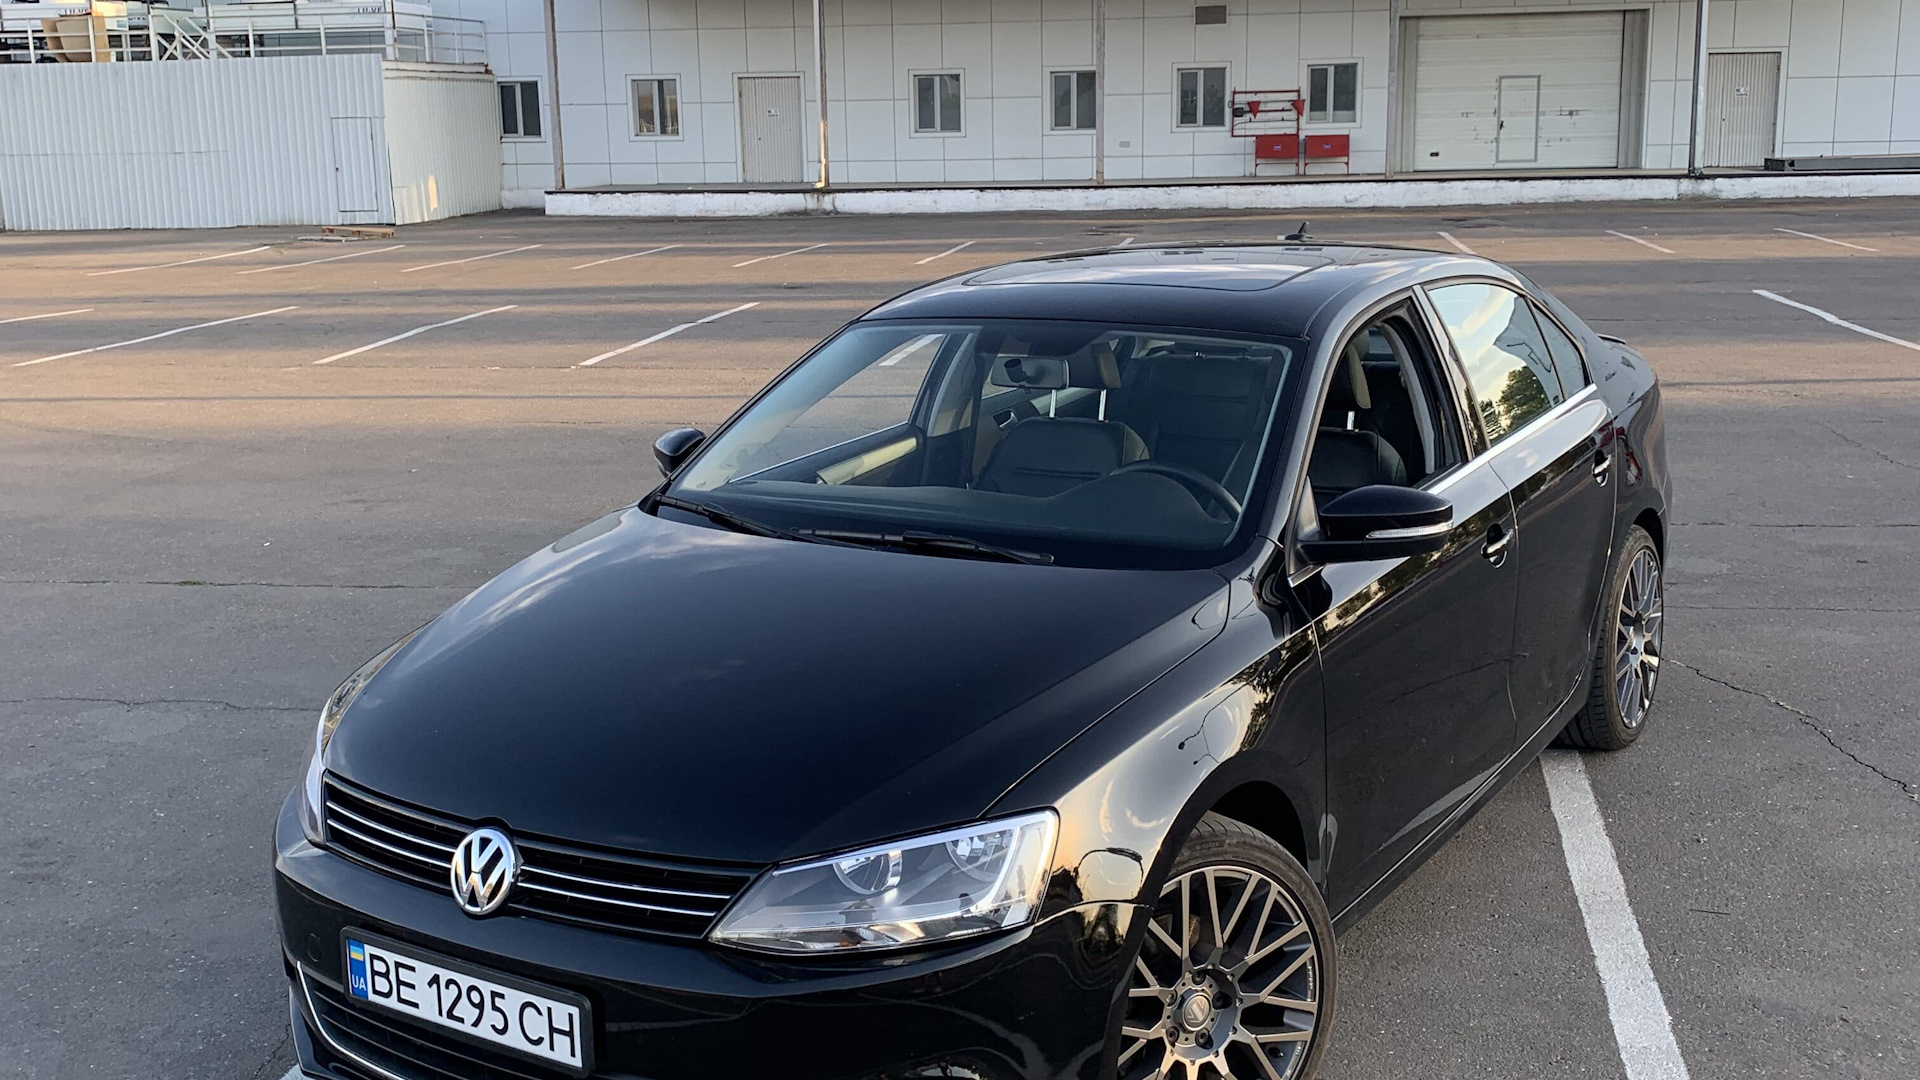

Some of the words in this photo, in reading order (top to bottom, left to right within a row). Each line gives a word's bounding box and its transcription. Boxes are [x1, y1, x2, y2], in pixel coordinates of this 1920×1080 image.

[452, 829, 516, 914] VW
[352, 974, 367, 991] UA
[369, 952, 420, 1010] BE
[427, 973, 509, 1036] 1295
[518, 1001, 576, 1058] CH
